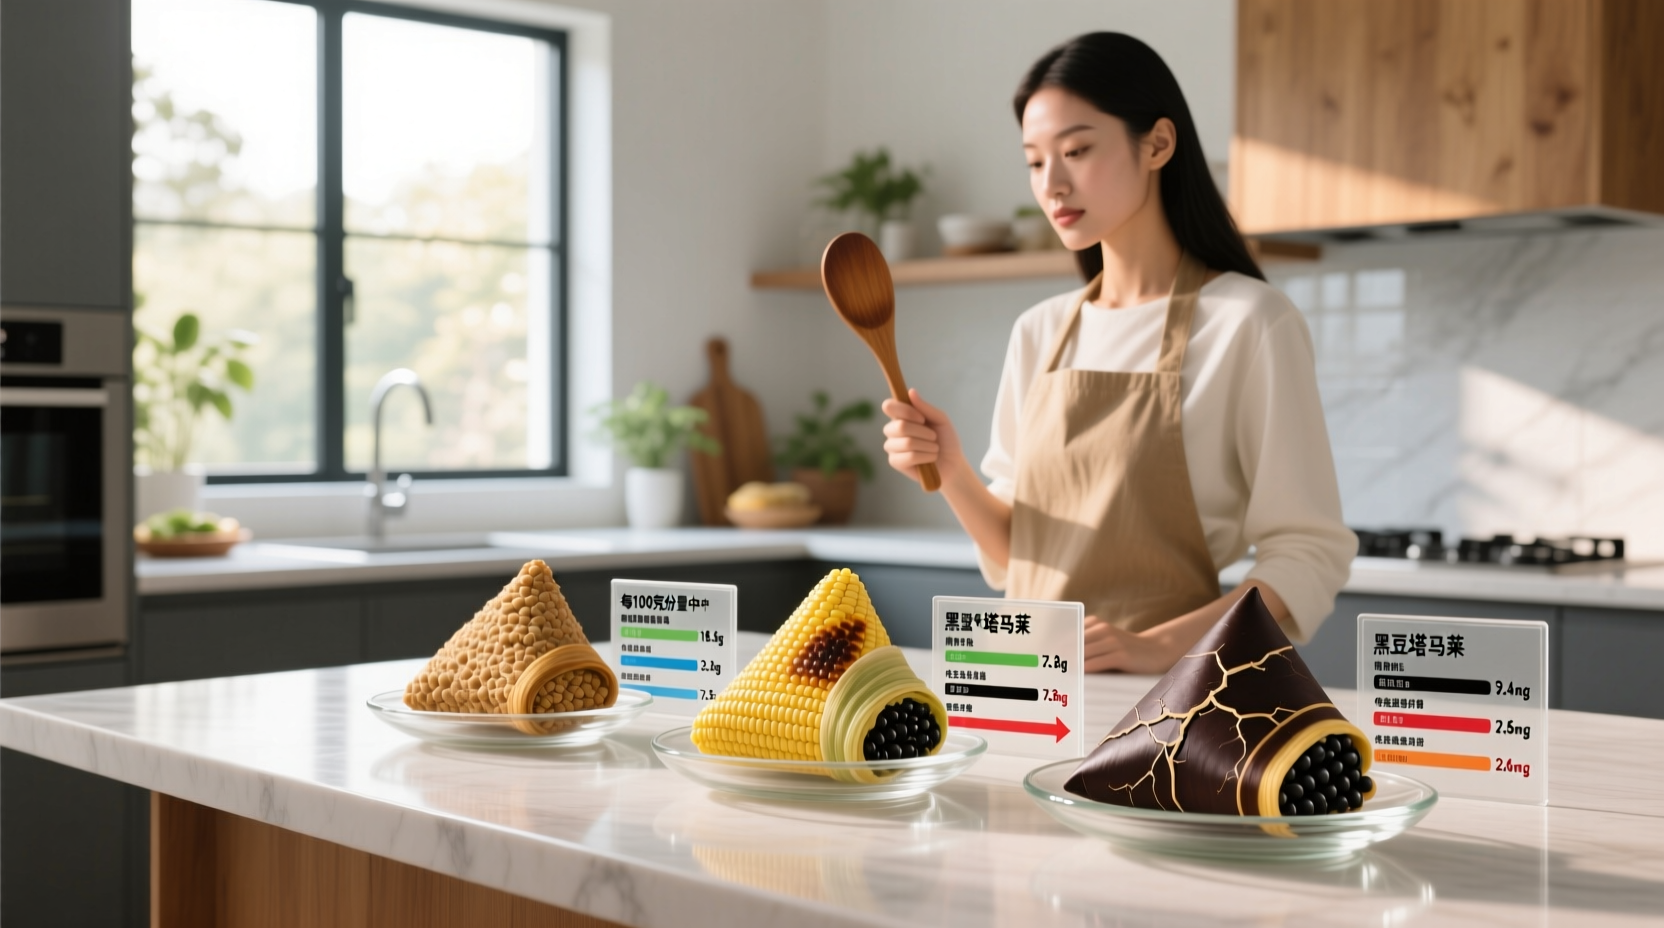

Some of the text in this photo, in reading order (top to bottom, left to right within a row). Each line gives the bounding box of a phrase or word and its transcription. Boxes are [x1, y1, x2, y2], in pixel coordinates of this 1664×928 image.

[1373, 632, 1466, 659] 黑豆塔马莱
